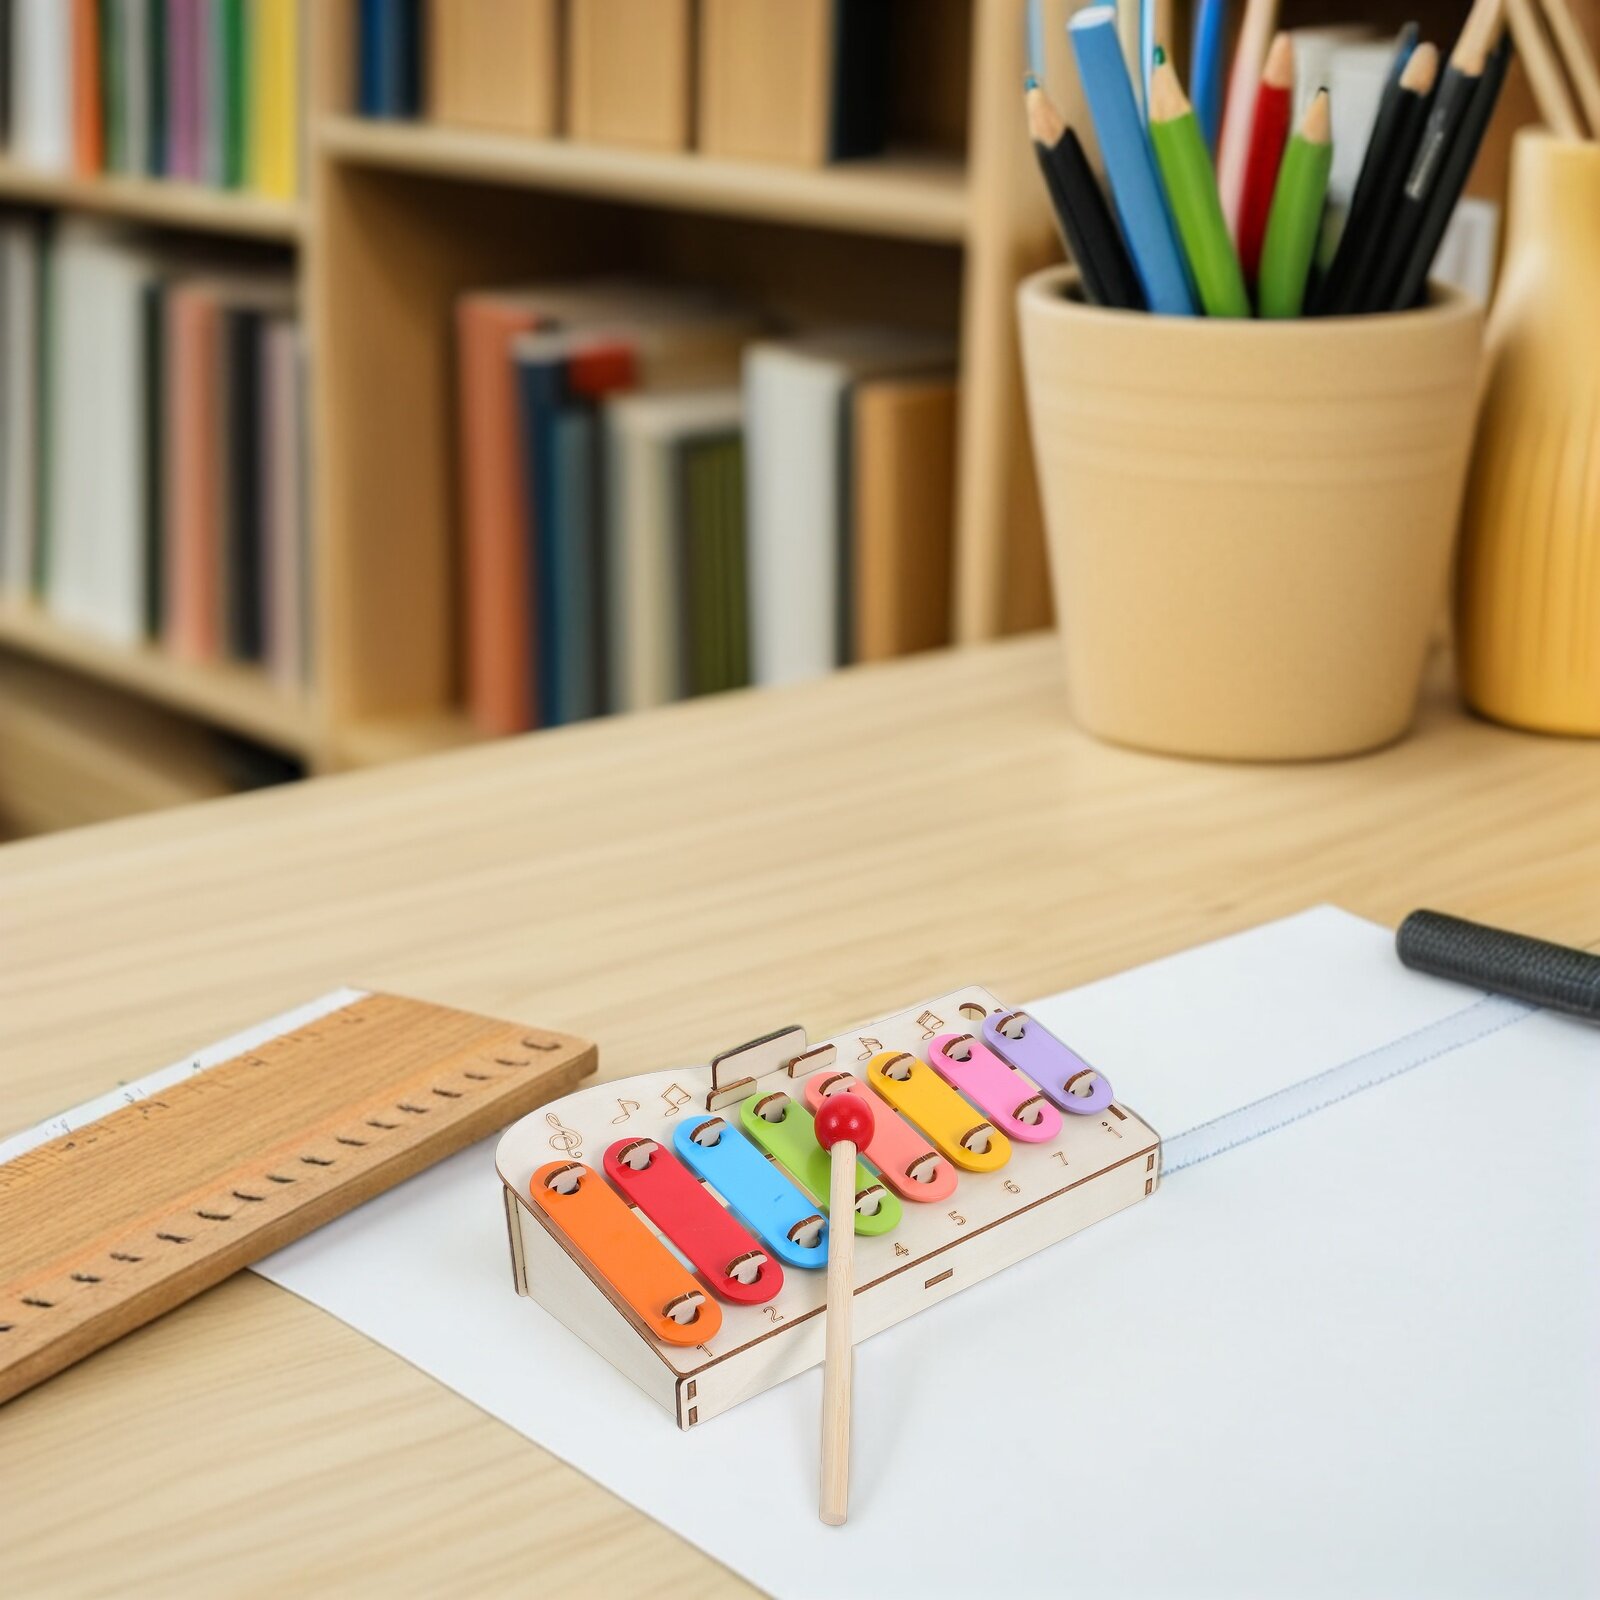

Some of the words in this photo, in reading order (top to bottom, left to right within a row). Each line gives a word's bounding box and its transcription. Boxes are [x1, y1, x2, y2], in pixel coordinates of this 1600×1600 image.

[696, 1343, 712, 1358] 1
[763, 1306, 783, 1323] 2
[894, 1242, 909, 1256] 4
[948, 1210, 966, 1226] 5
[1003, 1179, 1021, 1194] 6
[1051, 1151, 1069, 1166] 7
